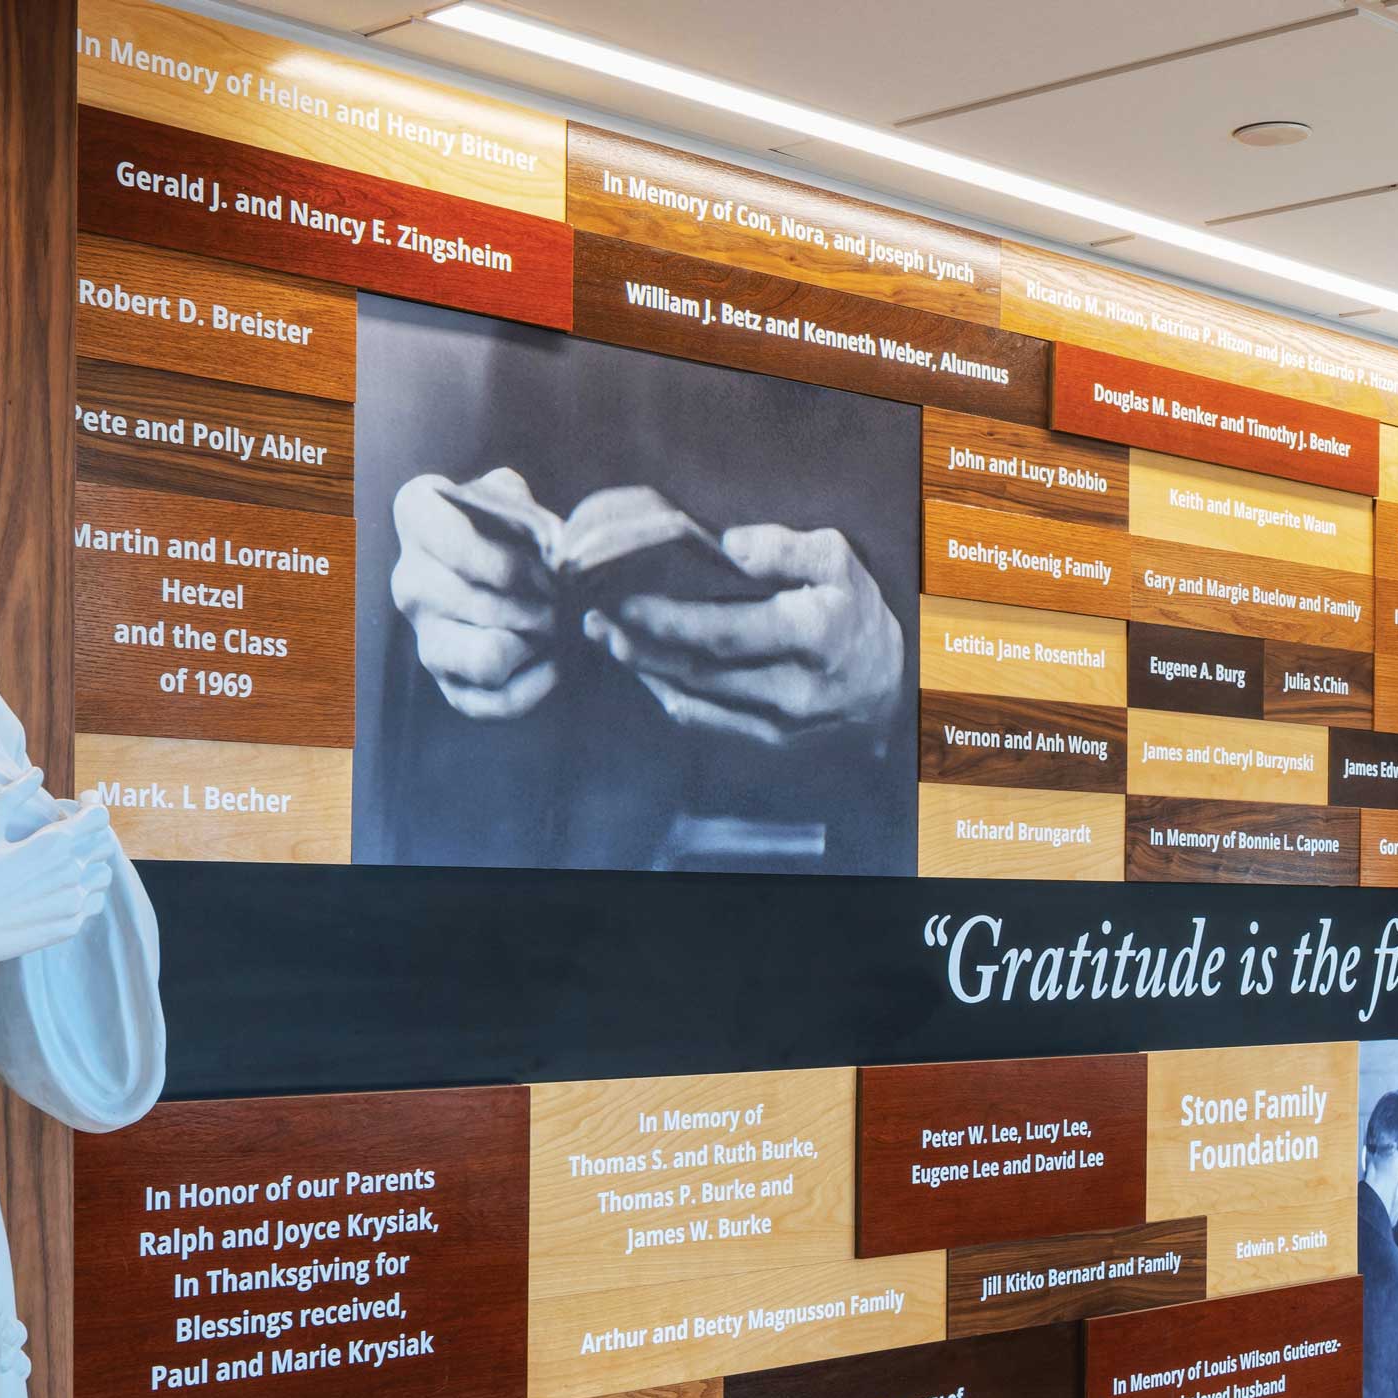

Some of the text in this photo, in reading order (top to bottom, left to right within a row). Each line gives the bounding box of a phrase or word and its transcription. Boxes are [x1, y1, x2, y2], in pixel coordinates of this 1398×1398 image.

[117, 161, 512, 273] Gerald J. and Nancy E. Zingsheim
[79, 278, 313, 345] Robert D. Breister
[1093, 382, 1351, 457] Douglas M. Benker and Timothy J. Benker
[135, 418, 184, 445] and
[193, 422, 255, 462] Polly
[260, 433, 327, 466] Abler
[947, 446, 1107, 493] John and Lucy Bobbio
[74, 523, 329, 576] Martin and Lorraine
[162, 577, 243, 610] Hetzel
[114, 621, 288, 657] and the Class
[160, 667, 253, 698] of 1969
[1150, 656, 1245, 688] Eugene A. Burg
[1282, 671, 1349, 695] Julia S.Chin
[944, 724, 1108, 761] Vernon and Anh Wong
[1342, 758, 1378, 779] James
[97, 781, 292, 813] Mark. L Becher
[1240, 920, 1274, 995] is
[1291, 917, 1361, 995] the
[1181, 1084, 1327, 1126] Stone Family
[922, 1118, 1091, 1149] Peter W. Lee, Lucy Lee,
[1189, 1130, 1319, 1172] Foundation
[146, 1168, 435, 1211] In Honor of our Parents
[912, 1149, 1104, 1188] Eugene Lee and David Lee
[140, 1206, 439, 1260] Ralph and Joyce Krysiak,
[174, 1251, 410, 1298] In Thanksgiving for
[176, 1292, 406, 1343] Blessings received,
[151, 1330, 434, 1390] Paul and Marie Krysiak
